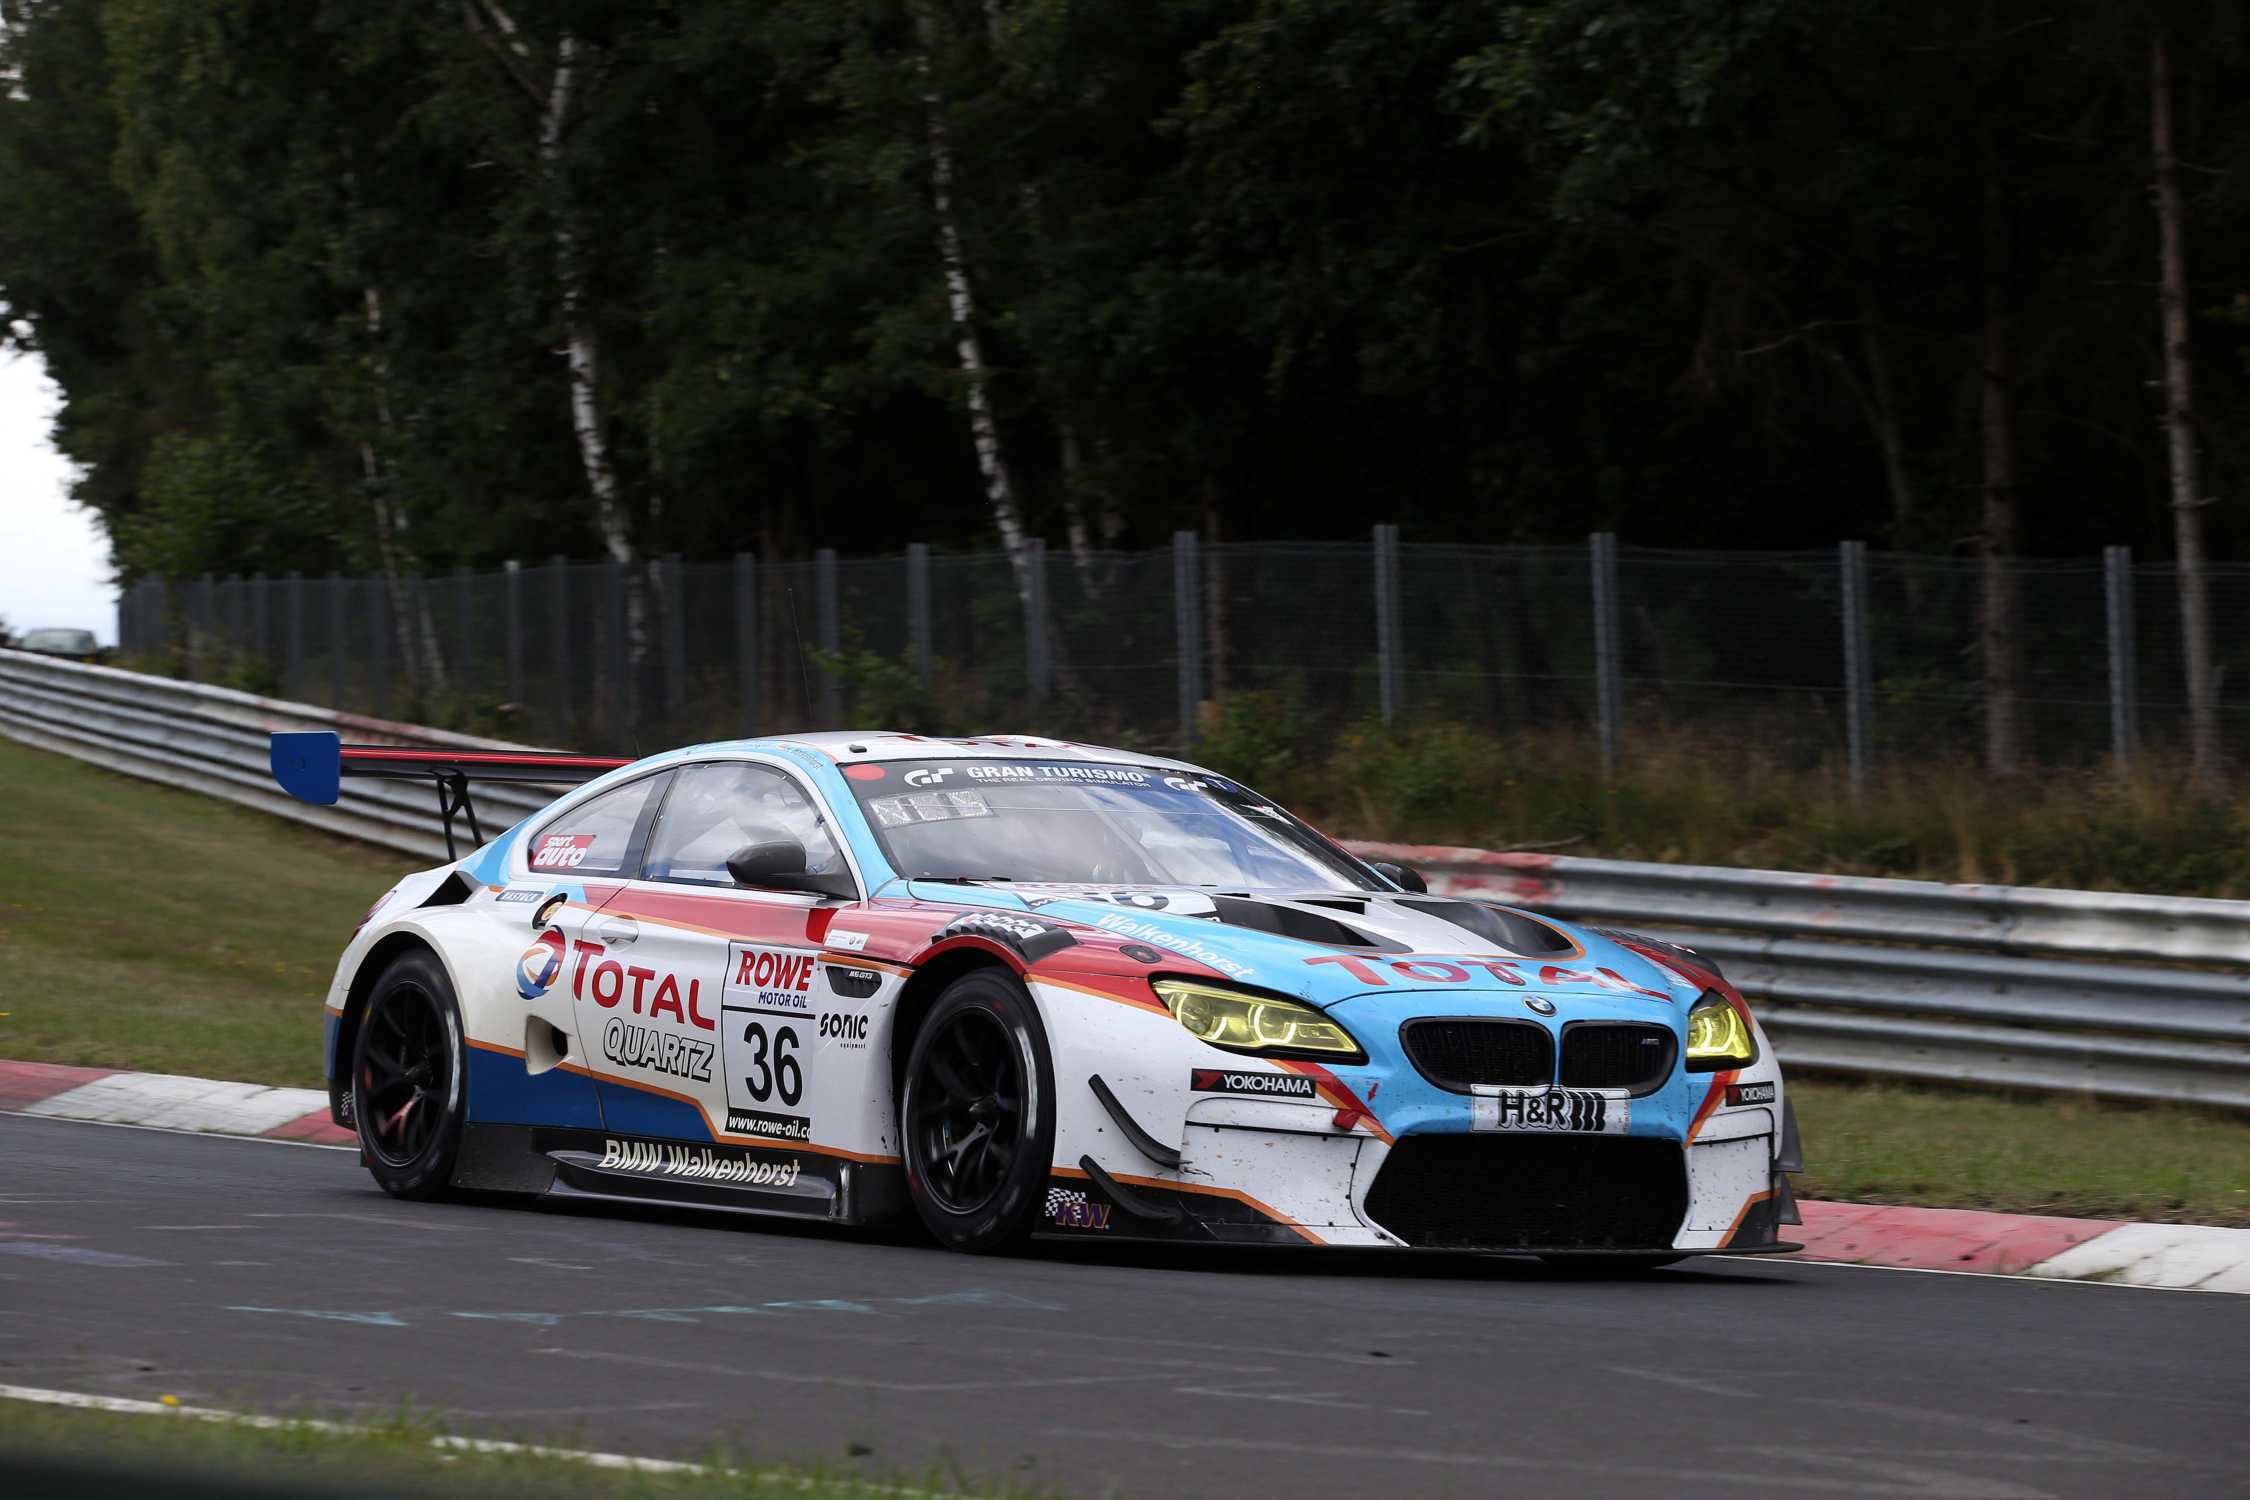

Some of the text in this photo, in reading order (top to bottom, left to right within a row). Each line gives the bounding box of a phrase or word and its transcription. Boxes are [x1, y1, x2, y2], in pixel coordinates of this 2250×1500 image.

[966, 766, 1034, 778] GRAN
[1039, 767, 1145, 782] TURISMO
[533, 848, 587, 867] auto
[1096, 912, 1255, 977] Walkenhorst
[572, 939, 715, 1032] TOTAL
[735, 951, 815, 992] ROWE
[1304, 955, 1673, 1002] TOTAL
[758, 991, 808, 1009] MOTOR OIL
[603, 1017, 714, 1083] QUARTZ
[743, 1021, 803, 1107] 36
[1223, 1074, 1313, 1094] YOKOHAMA
[597, 1139, 801, 1188] BMW Walkenhorst
